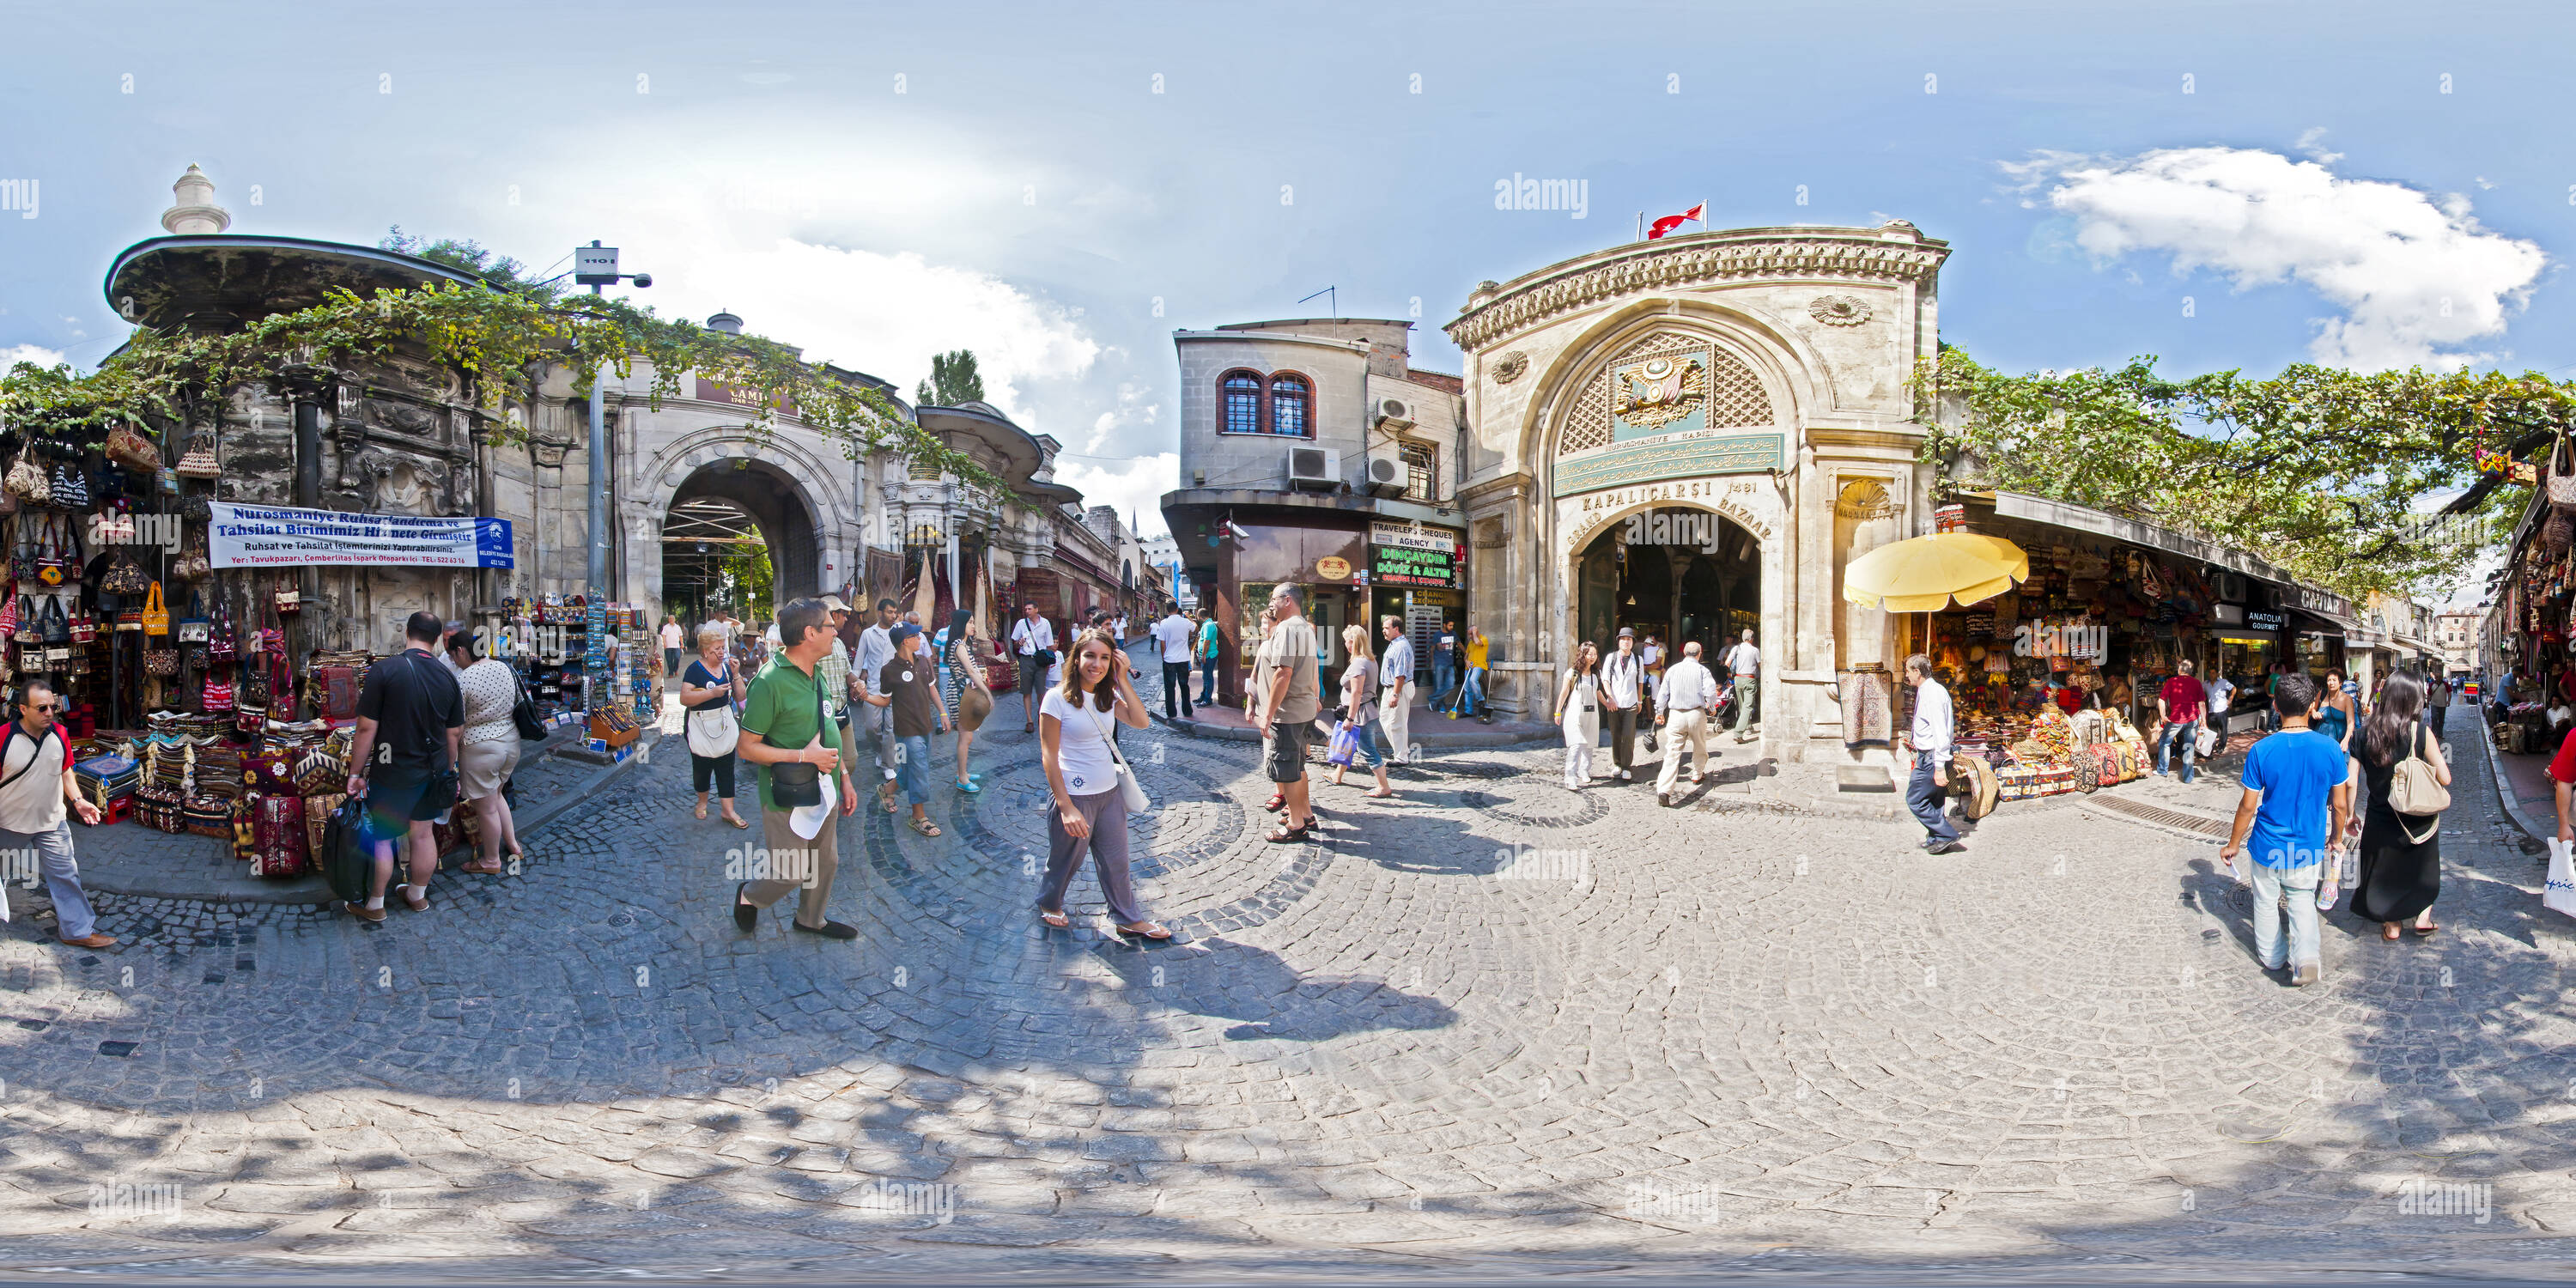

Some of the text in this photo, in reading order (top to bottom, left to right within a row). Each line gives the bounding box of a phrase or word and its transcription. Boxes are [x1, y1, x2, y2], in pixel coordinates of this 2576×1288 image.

[233, 508, 334, 523] Nurosmaniye
[1718, 496, 1771, 541] BAZAAR
[217, 524, 282, 537] Tahsilat
[285, 524, 360, 537] Birimimiz
[420, 529, 472, 543] Girmiştir
[1374, 523, 1453, 539] TRAVELERS CHEQUES
[1567, 512, 1602, 546] GRAND
[245, 542, 279, 550] Ruhsat
[295, 542, 333, 550] Tahsilat
[392, 544, 455, 554] Yaptırabilirsiniz.
[1400, 538, 1429, 547] AGENCY
[250, 556, 302, 564] Tavukpazarı,
[304, 554, 352, 563] Çemberlitaş
[1382, 574, 1410, 582] CHANGE
[1413, 565, 1421, 575] &
[1423, 567, 1450, 579] ALTIN
[2301, 589, 2339, 615] CAVIAR
[2248, 611, 2282, 623] ANATOLIA
[2252, 622, 2279, 631] GOURMET
